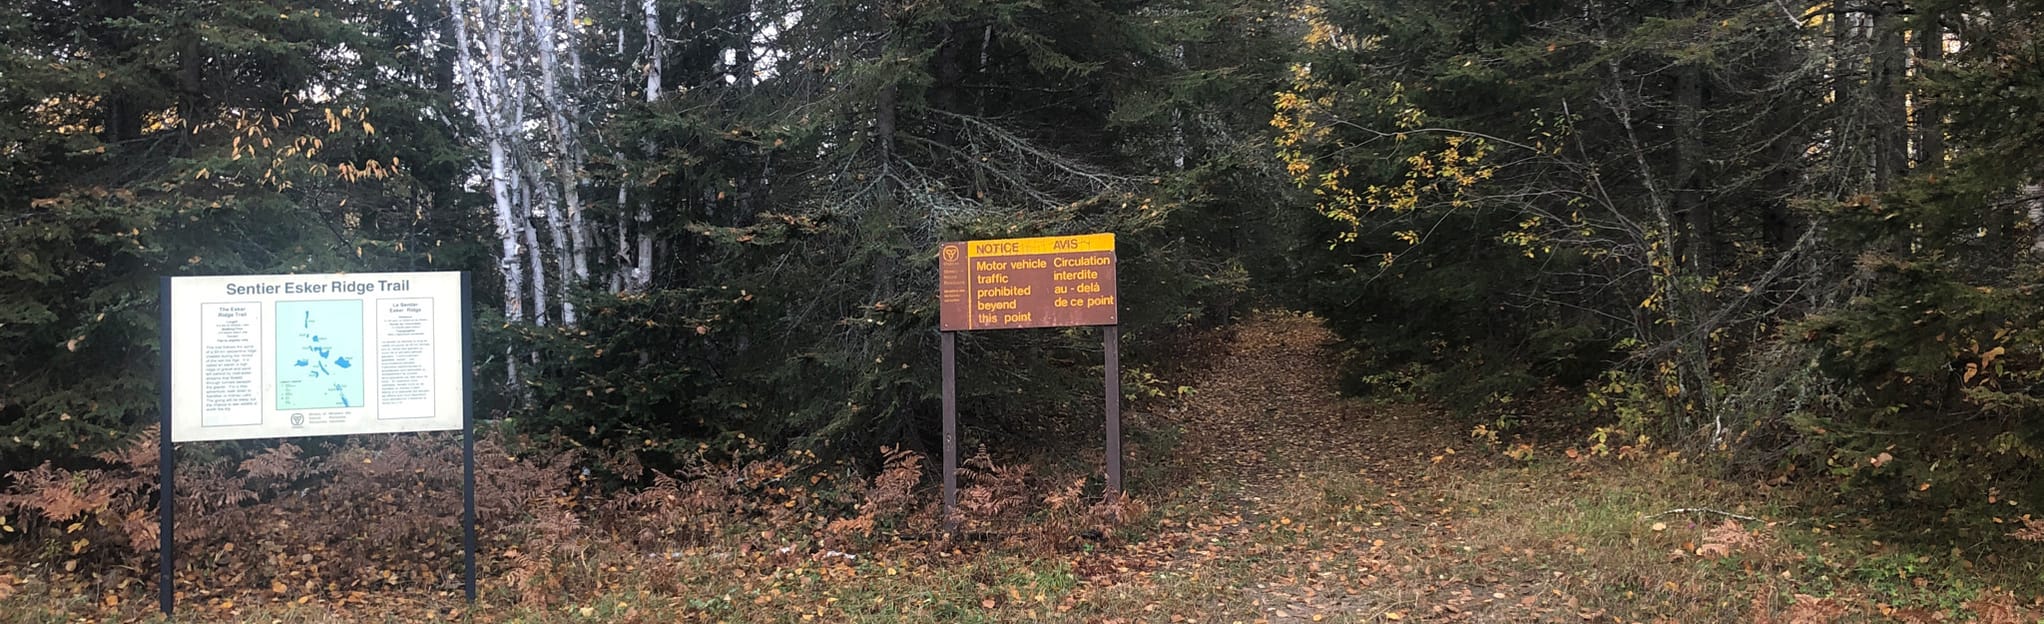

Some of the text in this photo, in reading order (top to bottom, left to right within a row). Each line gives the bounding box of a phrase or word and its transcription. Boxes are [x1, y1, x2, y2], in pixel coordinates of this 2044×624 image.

[976, 242, 1019, 254] NOTICE
[1053, 239, 1078, 250] AVIS
[976, 258, 1047, 271] Motor vehicle
[1053, 255, 1111, 268] Circulation
[977, 273, 1009, 285] traffic
[1053, 269, 1099, 281] interdite
[226, 279, 410, 295] Sentier Esker Ridge Trail
[977, 285, 1032, 300] prohibited
[1054, 285, 1068, 295] au
[977, 299, 1017, 312] beyond
[1054, 294, 1115, 309] de ce point
[978, 311, 1032, 325] this point
